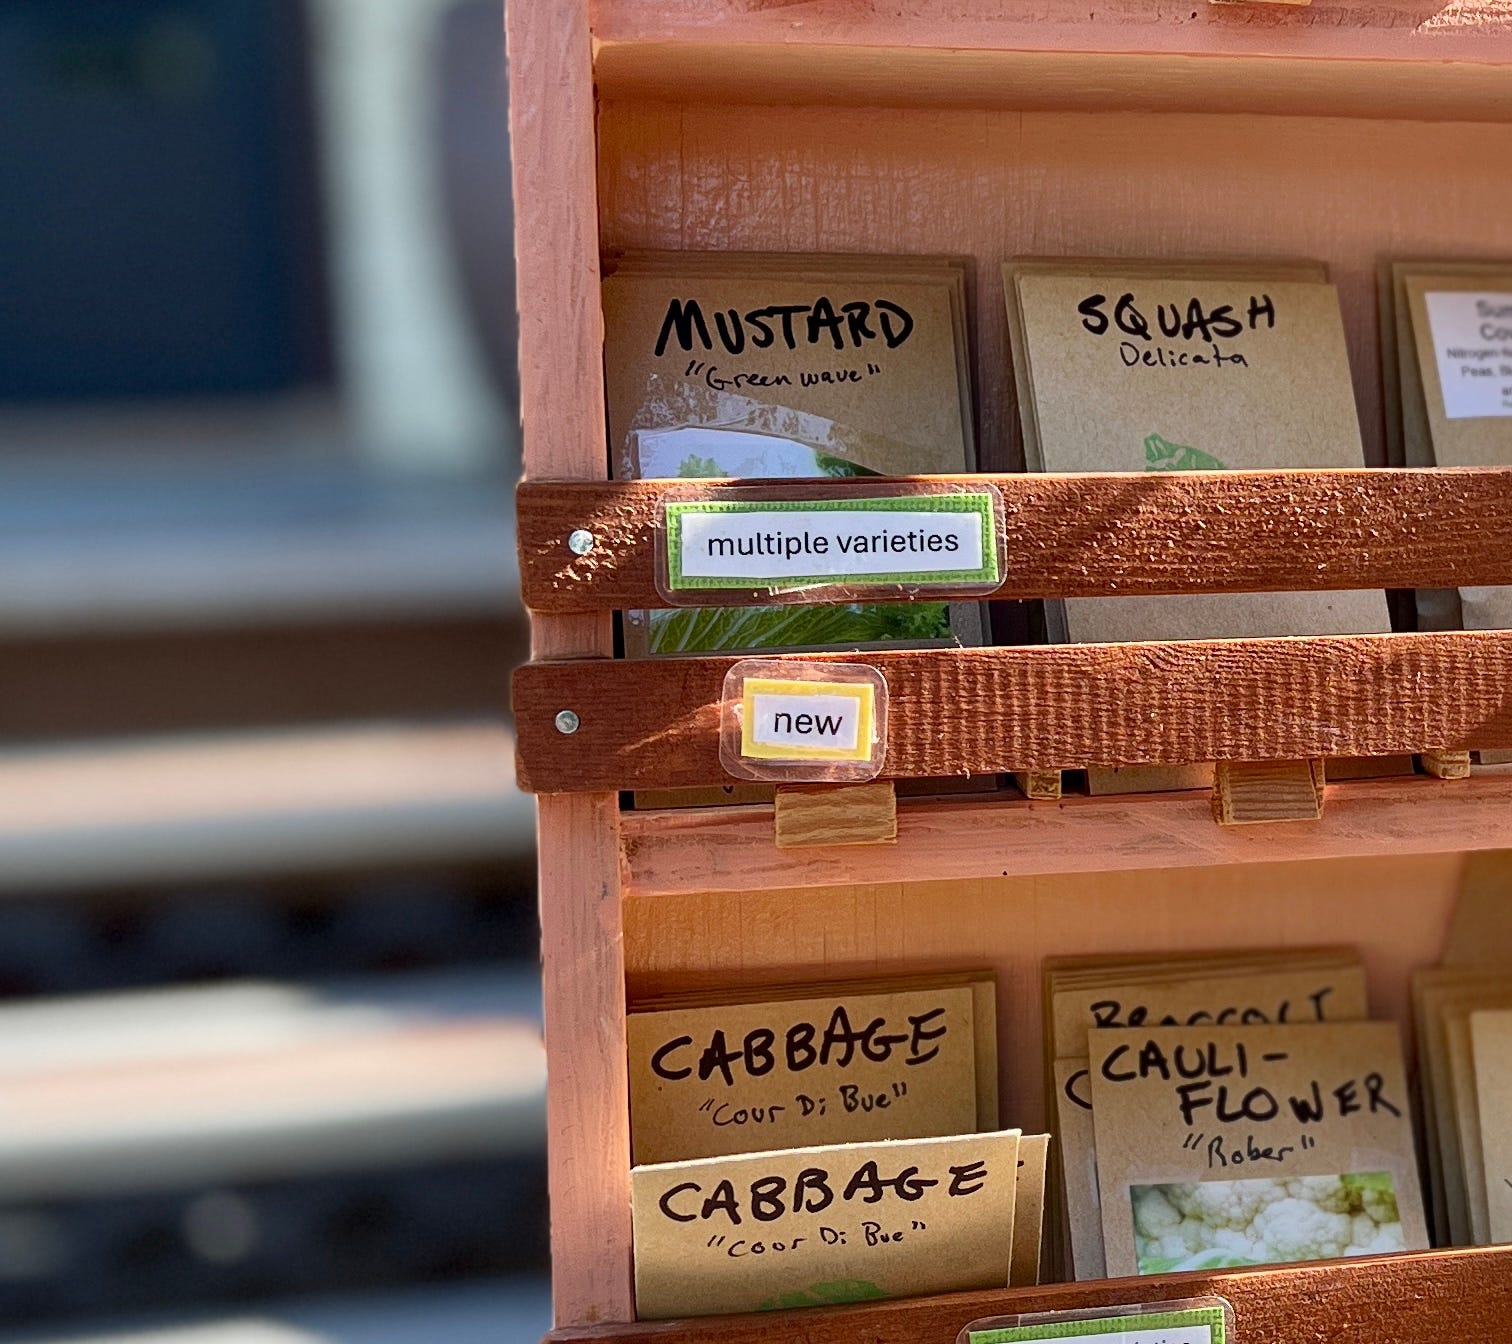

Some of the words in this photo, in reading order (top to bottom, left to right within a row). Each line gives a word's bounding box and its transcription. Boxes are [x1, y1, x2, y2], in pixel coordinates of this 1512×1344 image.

[655, 297, 914, 356] MUSTARD
[1078, 293, 1275, 342] SQUASH
[1120, 342, 1249, 367] Delicata
[707, 530, 830, 560] multiple
[836, 528, 960, 554] varieties
[773, 712, 843, 736] new
[651, 1006, 948, 1086] CABBAGE
[1101, 1040, 1289, 1082] CAULI-
[795, 1094, 827, 1119] Di
[1175, 1072, 1402, 1126] FLOWER
[659, 1160, 989, 1225] CABBAGE
